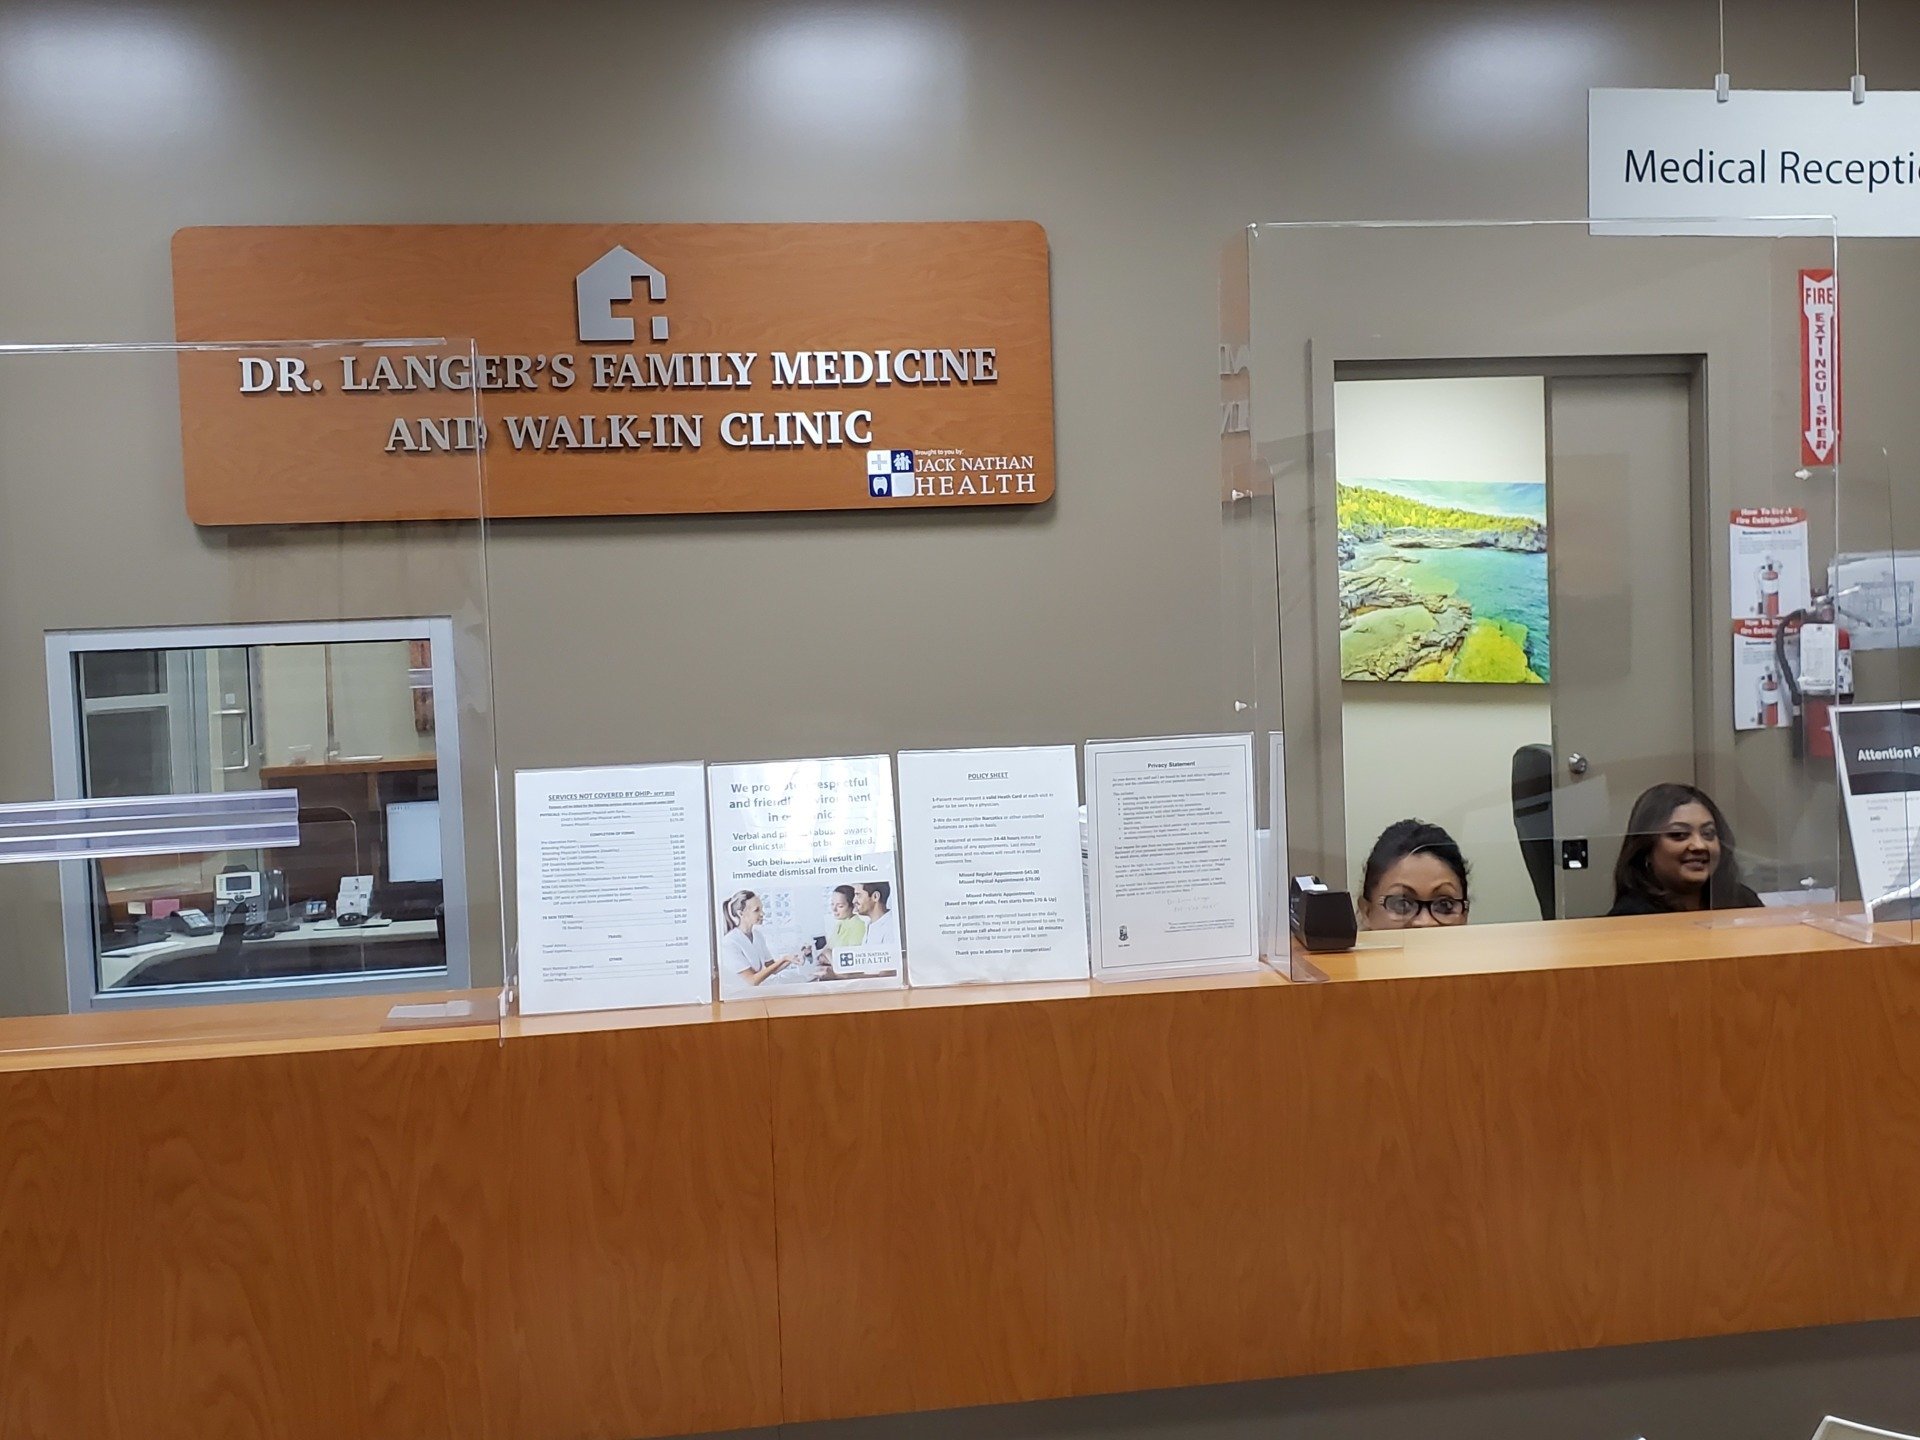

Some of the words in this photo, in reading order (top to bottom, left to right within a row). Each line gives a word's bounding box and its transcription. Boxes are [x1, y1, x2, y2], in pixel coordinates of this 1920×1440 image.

[1624, 149, 1766, 183] Medical
[1780, 151, 1920, 193] Recepti
[1806, 288, 1833, 304] FIRE
[238, 356, 323, 392] DR.
[591, 351, 757, 388] FAMILY
[772, 348, 998, 386] MEDICINE
[1814, 313, 1827, 450] EXTINGUISHER
[384, 417, 488, 451] AND
[503, 414, 703, 450] WALK-IN
[720, 410, 872, 446] CLINIC
[915, 458, 956, 472] JACK
[960, 456, 1034, 471] NATHAN
[916, 473, 1036, 496] HEALTH
[1858, 746, 1912, 761] Attention
[1148, 762, 1168, 770] Privacy
[1168, 760, 1196, 768] Statement
[731, 783, 748, 793] We
[729, 799, 750, 809] and
[768, 813, 778, 822] in
[733, 832, 759, 841] Verbal
[748, 843, 769, 851] clinic
[748, 858, 767, 867] Such
[829, 854, 852, 862] result
[733, 869, 777, 879] immediate
[779, 867, 815, 876] dismissal
[818, 866, 837, 874] from
[855, 864, 878, 872] clinic.
[855, 956, 891, 964] HEALTH
